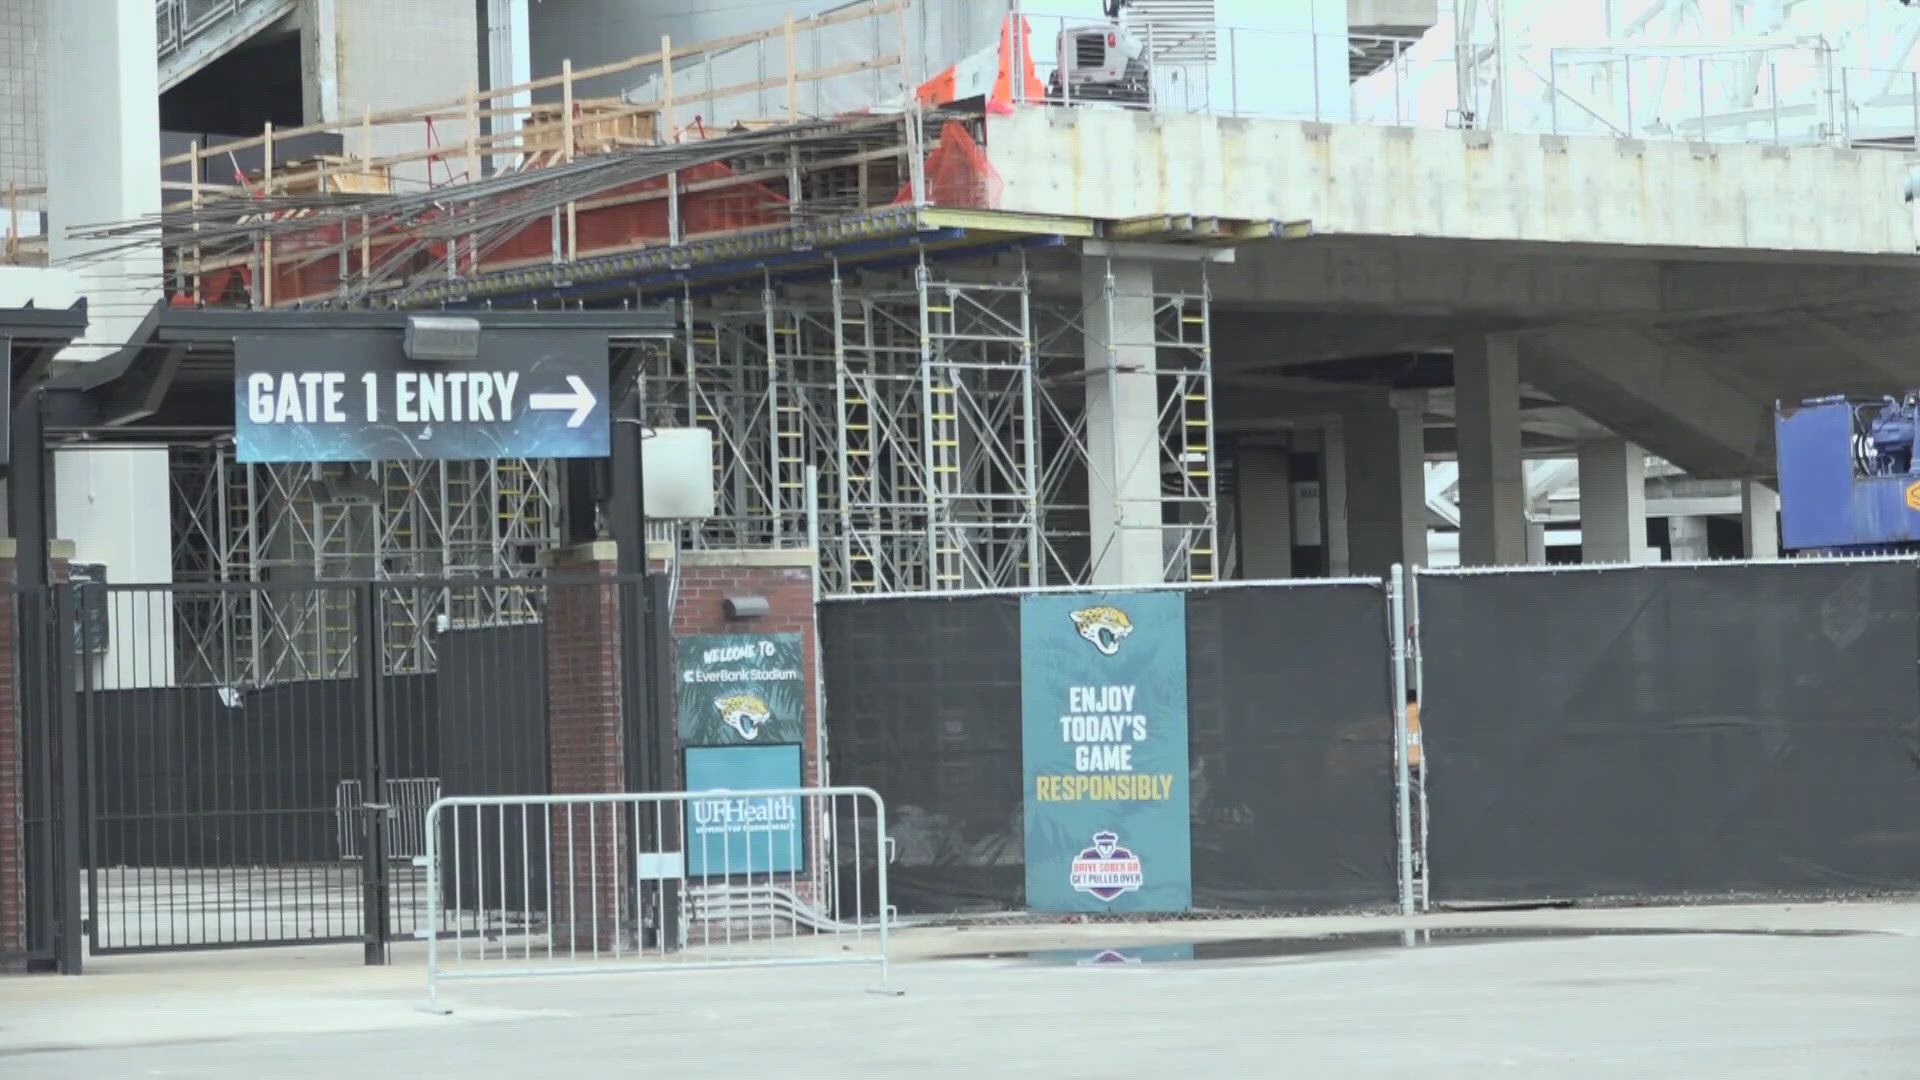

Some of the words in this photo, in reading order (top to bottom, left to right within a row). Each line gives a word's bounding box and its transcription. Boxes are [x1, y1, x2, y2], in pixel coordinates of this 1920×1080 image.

[248, 372, 346, 423] GATE
[361, 372, 378, 422] 1
[396, 371, 519, 422] ENTRY
[704, 644, 755, 664] WELCOME
[758, 641, 775, 656] TO
[696, 668, 748, 682] EverBank
[751, 669, 797, 681] Stadium
[1069, 685, 1136, 713] ENJOY
[1060, 715, 1147, 742] TODAY'S
[1075, 745, 1133, 772] GAME
[1037, 774, 1173, 801] RESPONSIBLY
[1072, 874, 1087, 884] GET
[1089, 874, 1119, 884] PULLED
[1120, 873, 1141, 884] OVER
[1073, 863, 1096, 872] DRIVE
[1100, 862, 1126, 872] SOBER
[1127, 862, 1139, 872] OR
